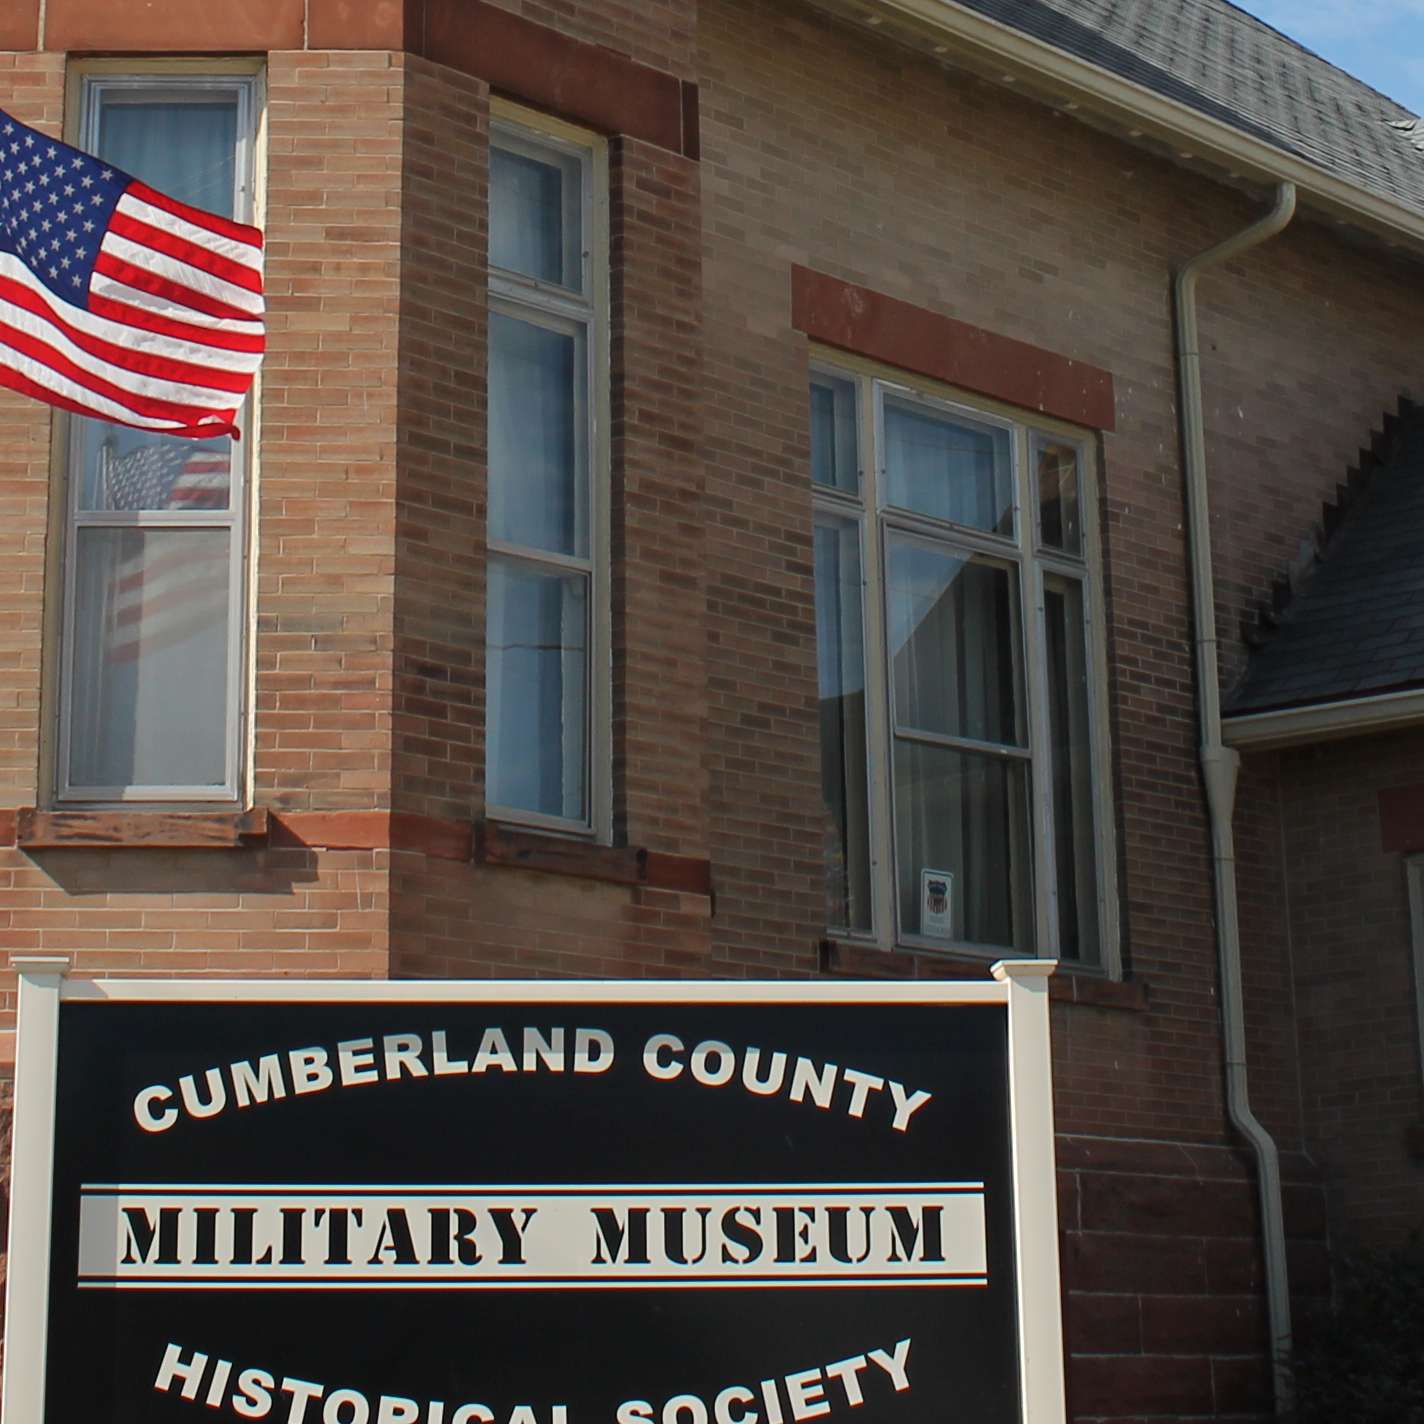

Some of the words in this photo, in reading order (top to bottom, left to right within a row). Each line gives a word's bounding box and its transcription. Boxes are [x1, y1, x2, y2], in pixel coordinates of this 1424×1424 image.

[133, 1027, 615, 1132] CUMBERLAND
[642, 1033, 932, 1132] COUNTY
[120, 1207, 538, 1266] MILITARY
[590, 1205, 946, 1265] MUSEUM
[616, 1338, 911, 1424] SOCIETY
